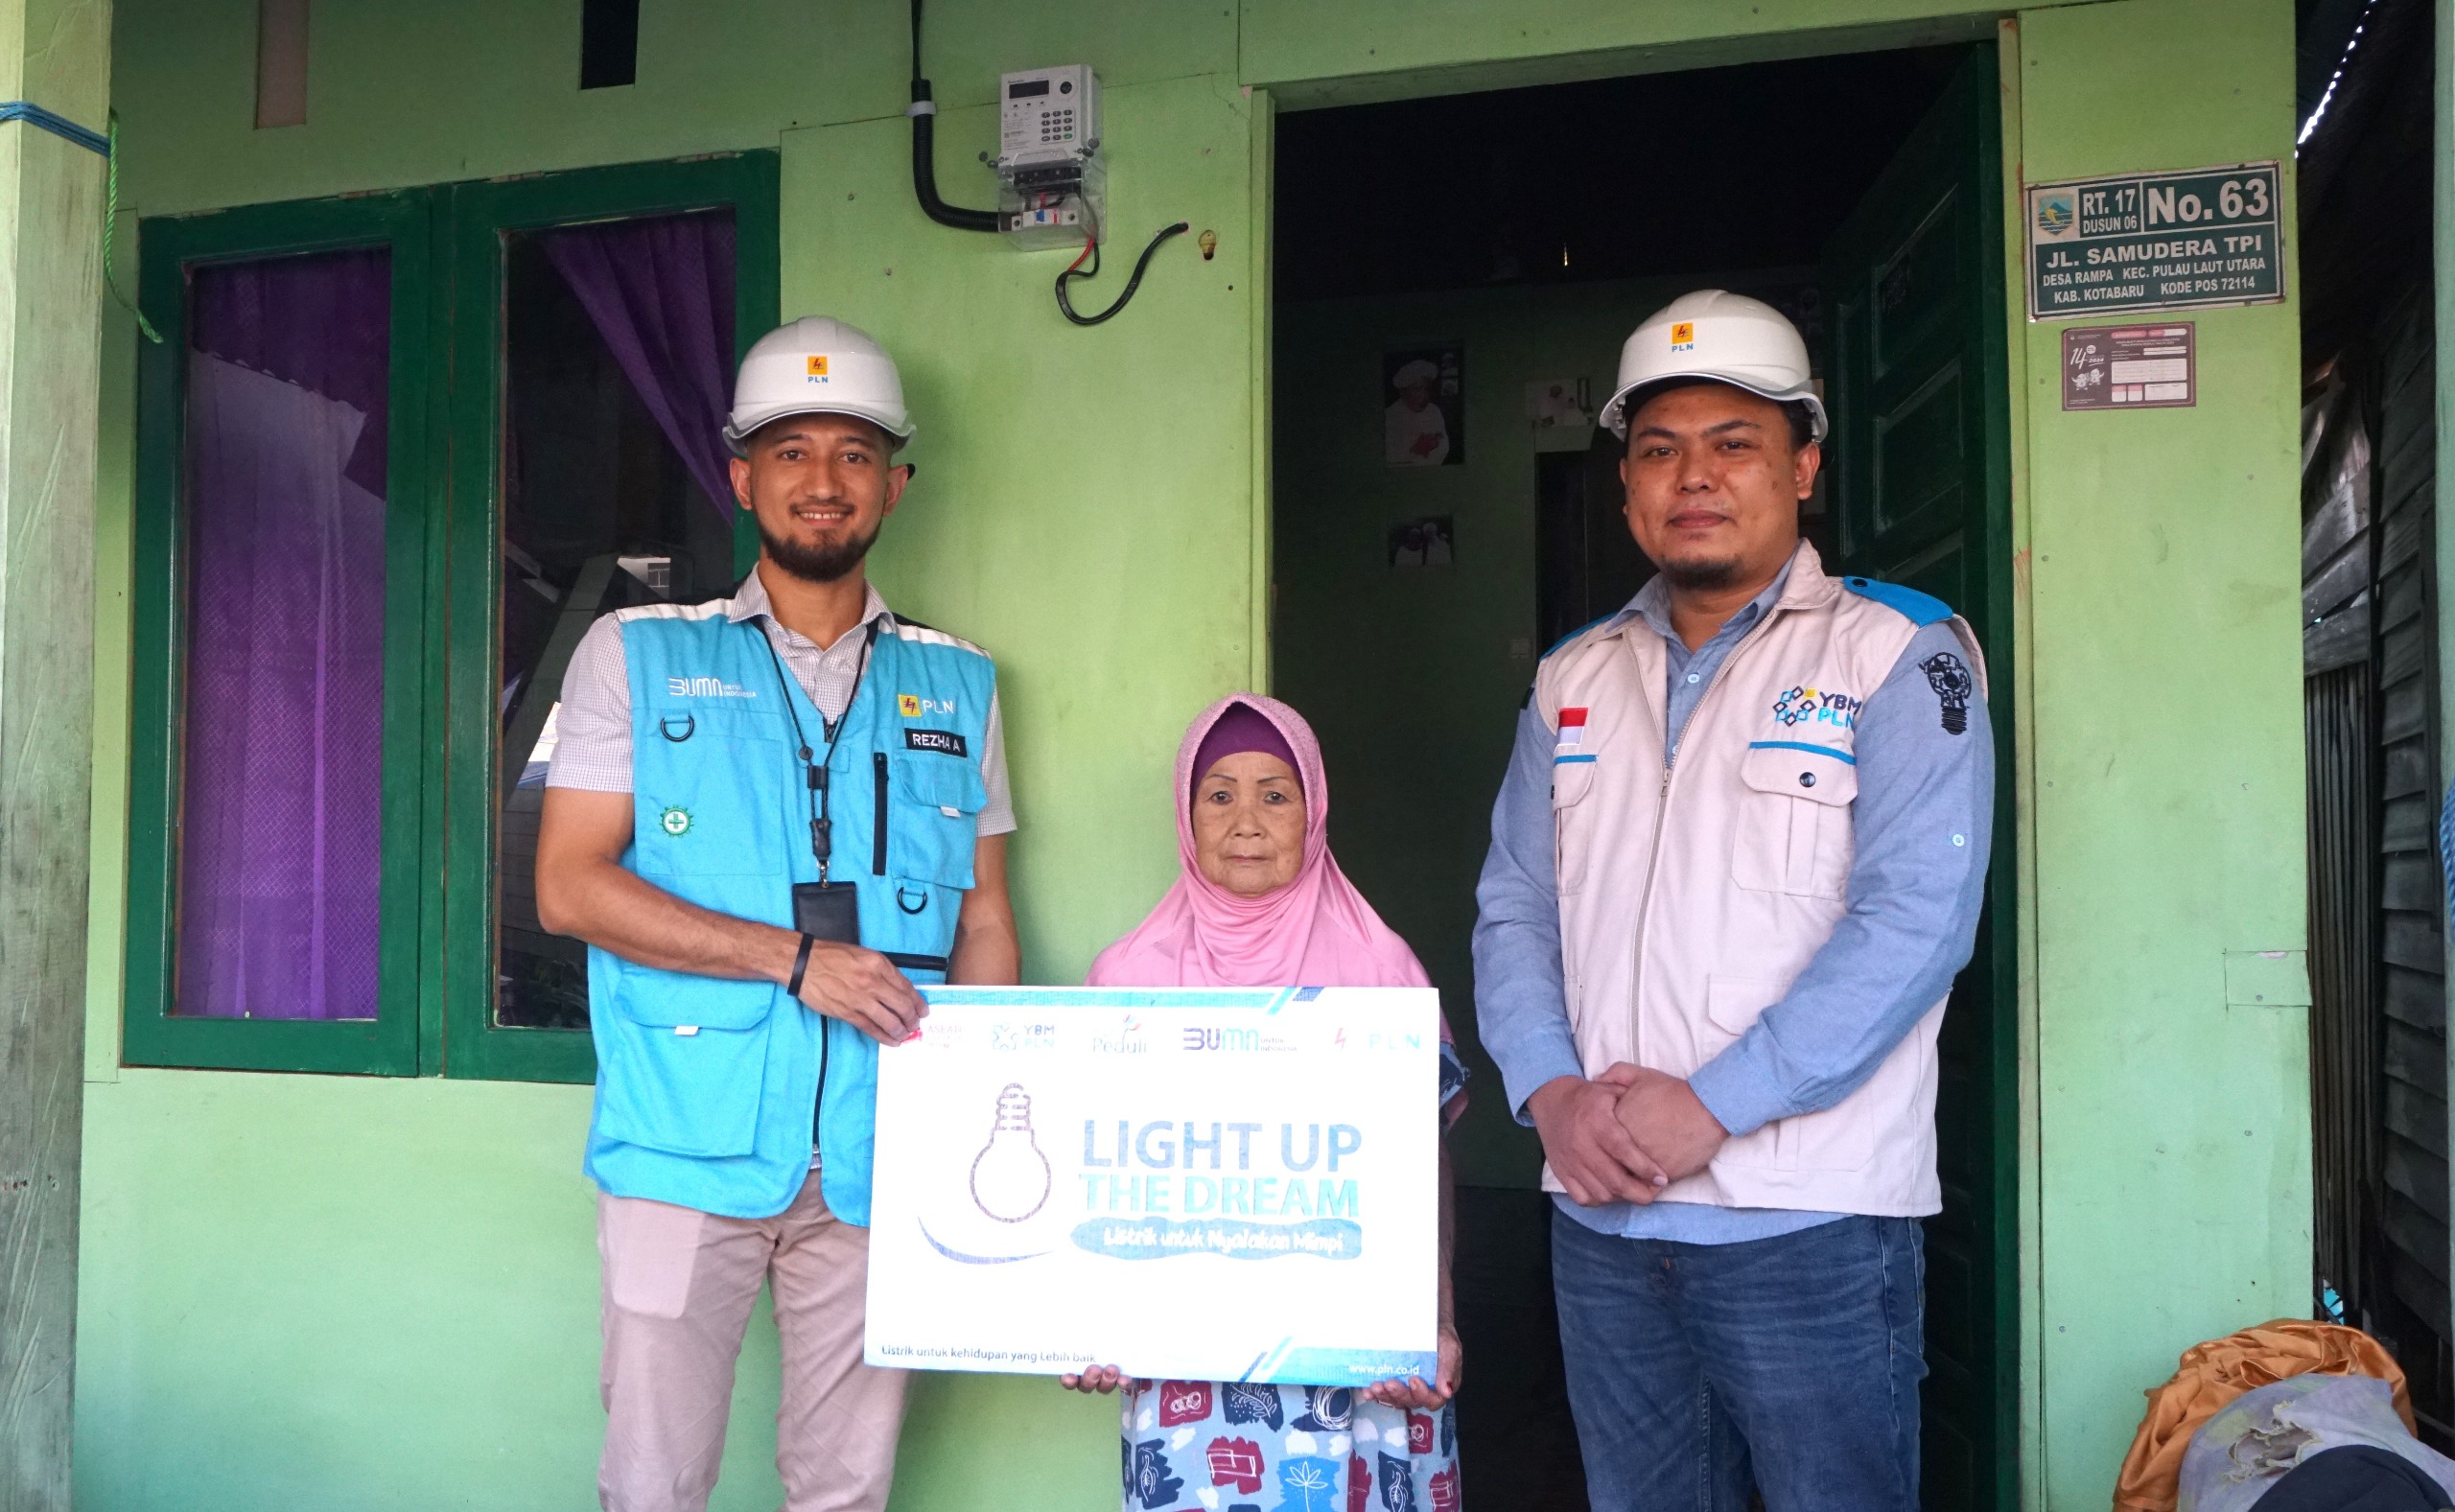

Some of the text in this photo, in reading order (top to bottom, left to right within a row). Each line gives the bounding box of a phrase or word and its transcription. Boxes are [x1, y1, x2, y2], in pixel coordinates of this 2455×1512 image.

[2083, 189, 2136, 216] RT. 17
[2148, 178, 2268, 224] No. 63
[2083, 215, 2138, 234] DUSUN 06
[2046, 235, 2262, 268] JL. SAMUDERA TPI
[2043, 257, 2266, 287] DESA RAMPA KEC. PULAU LAUT UTARA
[2054, 276, 2256, 304] KAB. KOTABARU KODE POS 72114
[1672, 343, 1694, 352] PLN
[668, 677, 723, 697] BUMN
[923, 698, 955, 714] PLN
[1819, 691, 1862, 715] YBM
[912, 733, 960, 752] REZHA A
[1024, 1025, 1055, 1035] YBM
[1092, 1028, 1147, 1054] Peduli
[1182, 1028, 1259, 1051] BUMN
[1368, 1033, 1421, 1050] PLN
[1084, 1120, 1362, 1172] LIGHT UP
[1079, 1173, 1360, 1217] THE DREAM
[1104, 1227, 1344, 1257] Listrik untuk Nyalakan Mimpi
[881, 1345, 914, 1357] Listrik
[916, 1346, 948, 1358] untuk
[950, 1347, 1008, 1361] kehidupan
[1010, 1352, 1038, 1362] yang
[1072, 1351, 1096, 1363] baik
[1348, 1364, 1420, 1376] www.pln.co.id
